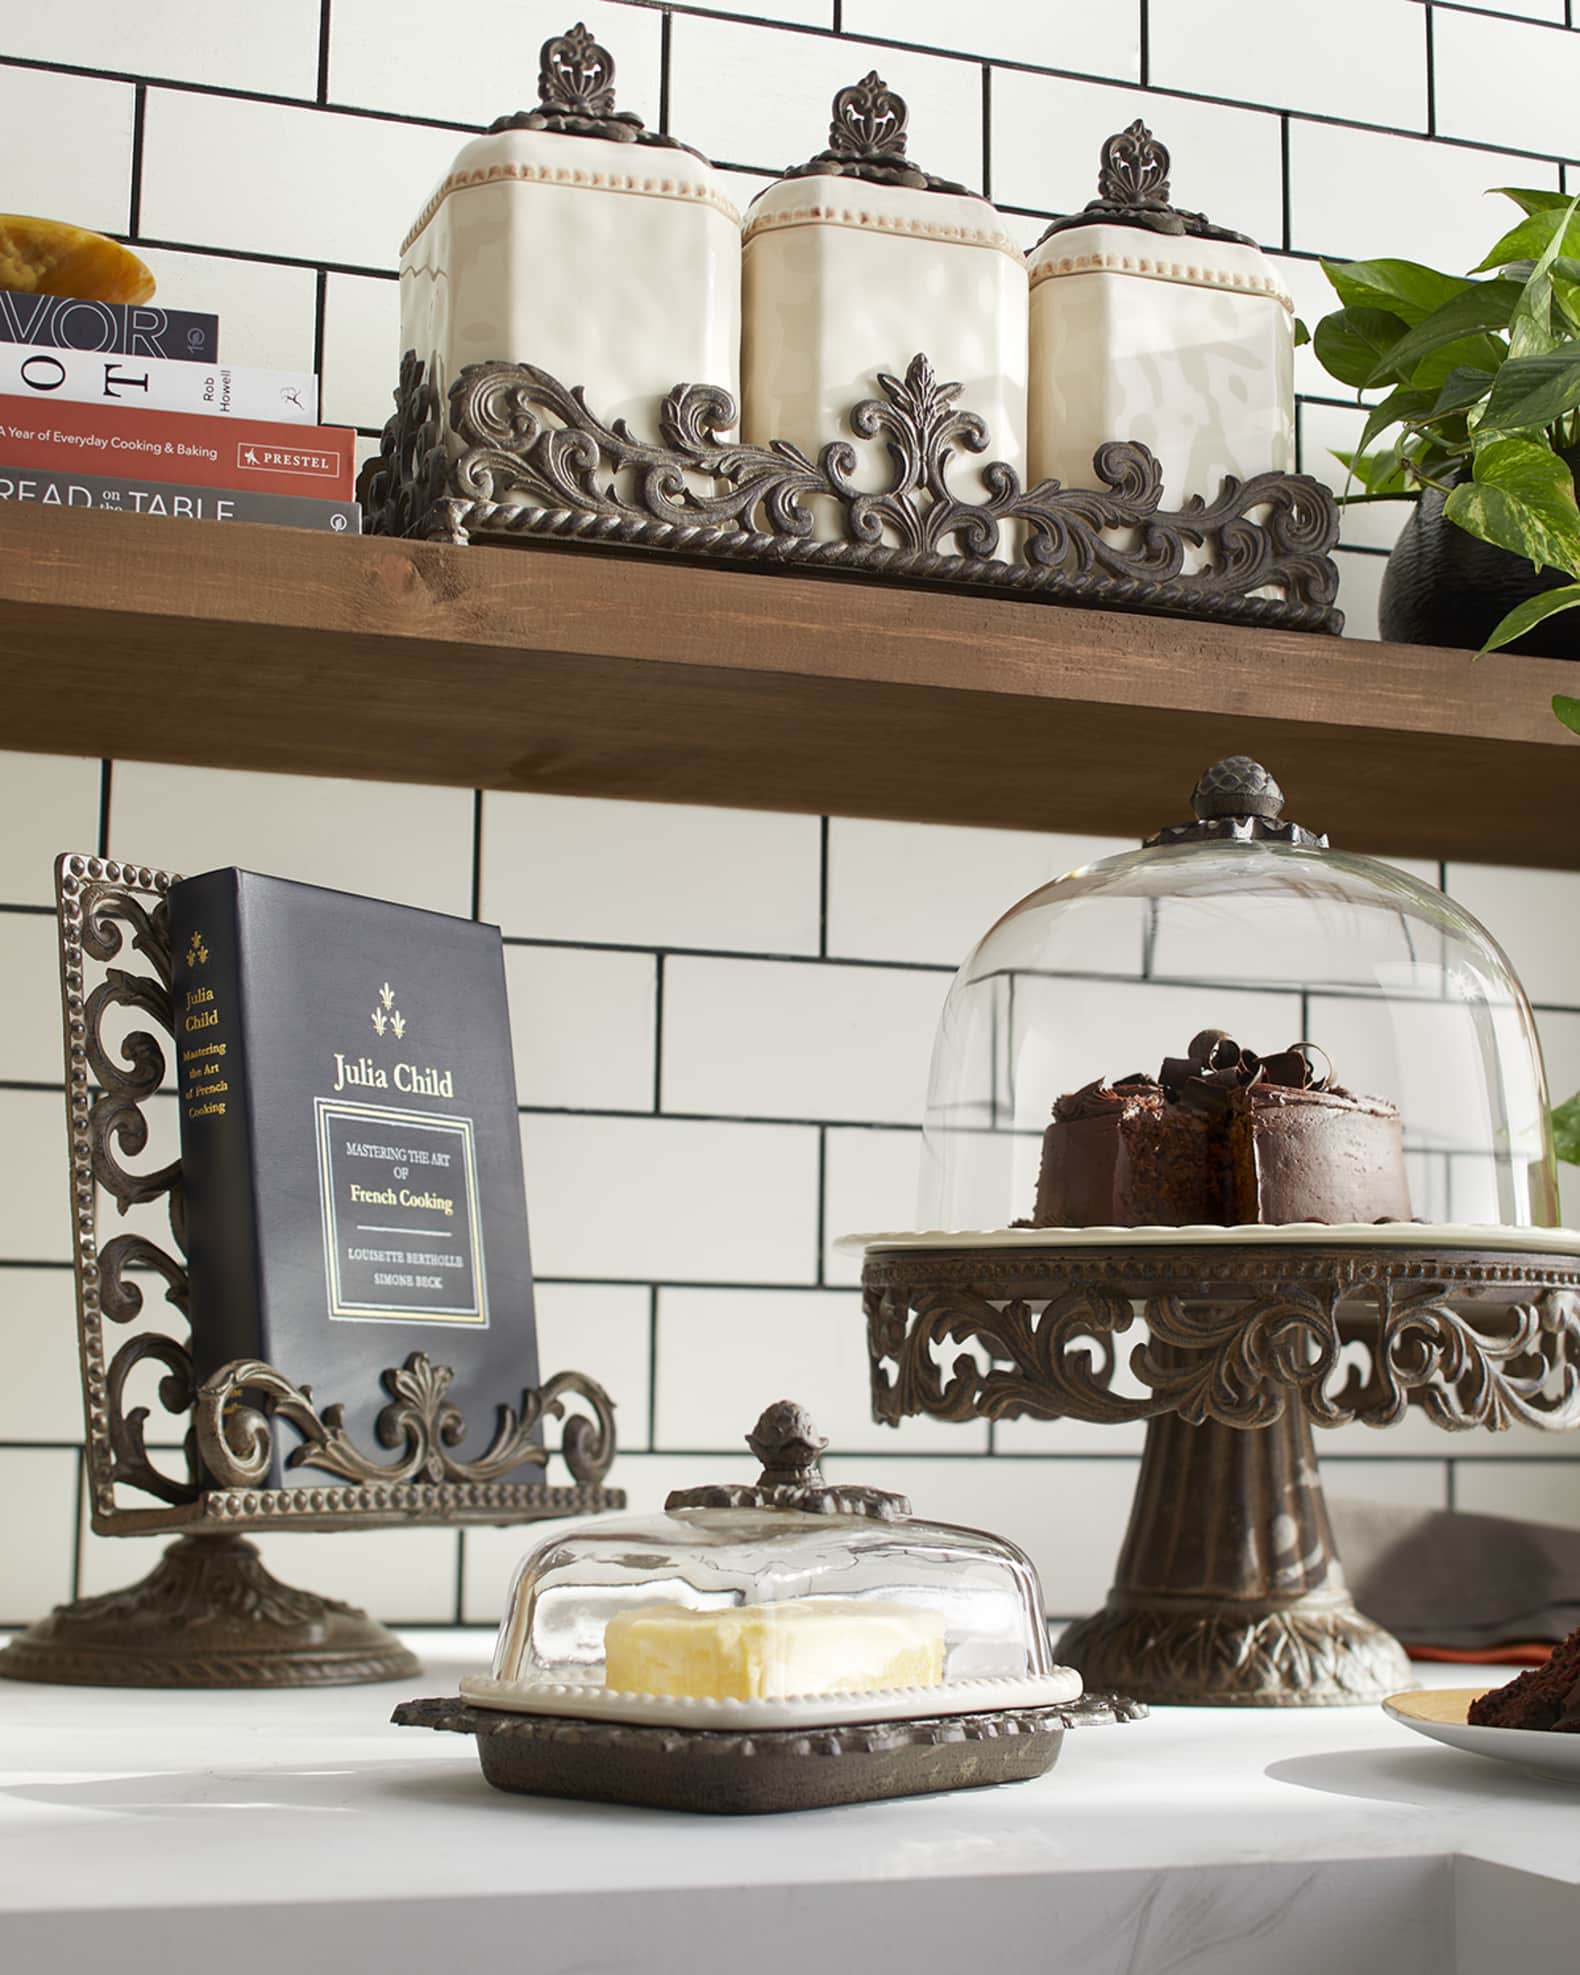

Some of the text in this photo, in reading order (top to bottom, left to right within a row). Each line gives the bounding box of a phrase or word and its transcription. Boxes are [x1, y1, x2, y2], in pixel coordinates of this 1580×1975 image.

[203, 377, 215, 402] Rob
[220, 370, 231, 412] Howell
[8, 426, 35, 440] Year
[37, 430, 51, 441] of
[53, 431, 108, 449] Everyday
[110, 437, 162, 455] Cooking
[164, 442, 174, 454] &
[177, 444, 218, 461] Baking
[263, 452, 329, 469] PRESTEL
[102, 490, 120, 501] on
[186, 987, 215, 1011] Julia
[184, 1009, 218, 1032] Child
[183, 1043, 226, 1061] Mastering
[204, 1063, 219, 1076] Art
[334, 1053, 454, 1098] Julia Child
[195, 1080, 228, 1097] French
[189, 1102, 226, 1118] Cooking
[346, 1141, 451, 1167] MASTERING THE ART
[393, 1166, 409, 1179] OF
[350, 1184, 453, 1216] French Cooking
[348, 1248, 404, 1263] LOUISETTE
[374, 1273, 443, 1289] SIMONE BECK
